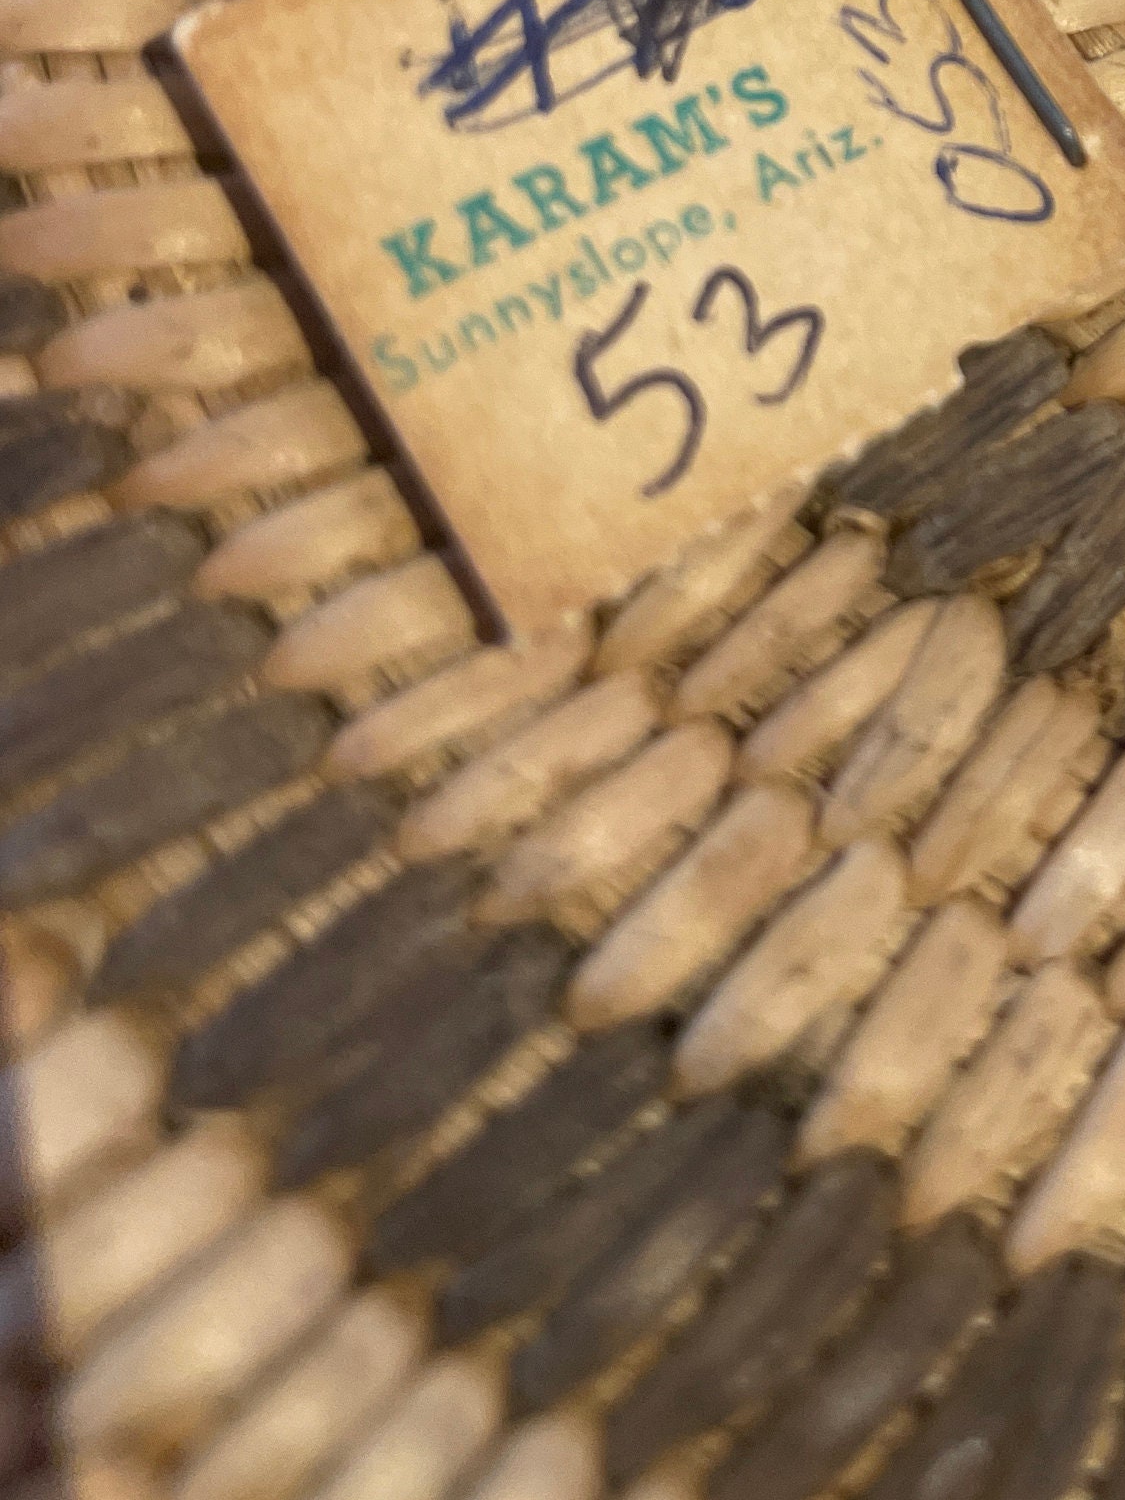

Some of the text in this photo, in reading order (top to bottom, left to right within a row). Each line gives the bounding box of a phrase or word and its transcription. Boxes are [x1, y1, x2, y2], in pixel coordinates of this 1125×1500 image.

[370, 125, 884, 393] Sunnyslope, Ariz.
[380, 65, 790, 300] KARAM'S
[573, 263, 826, 500] 53
